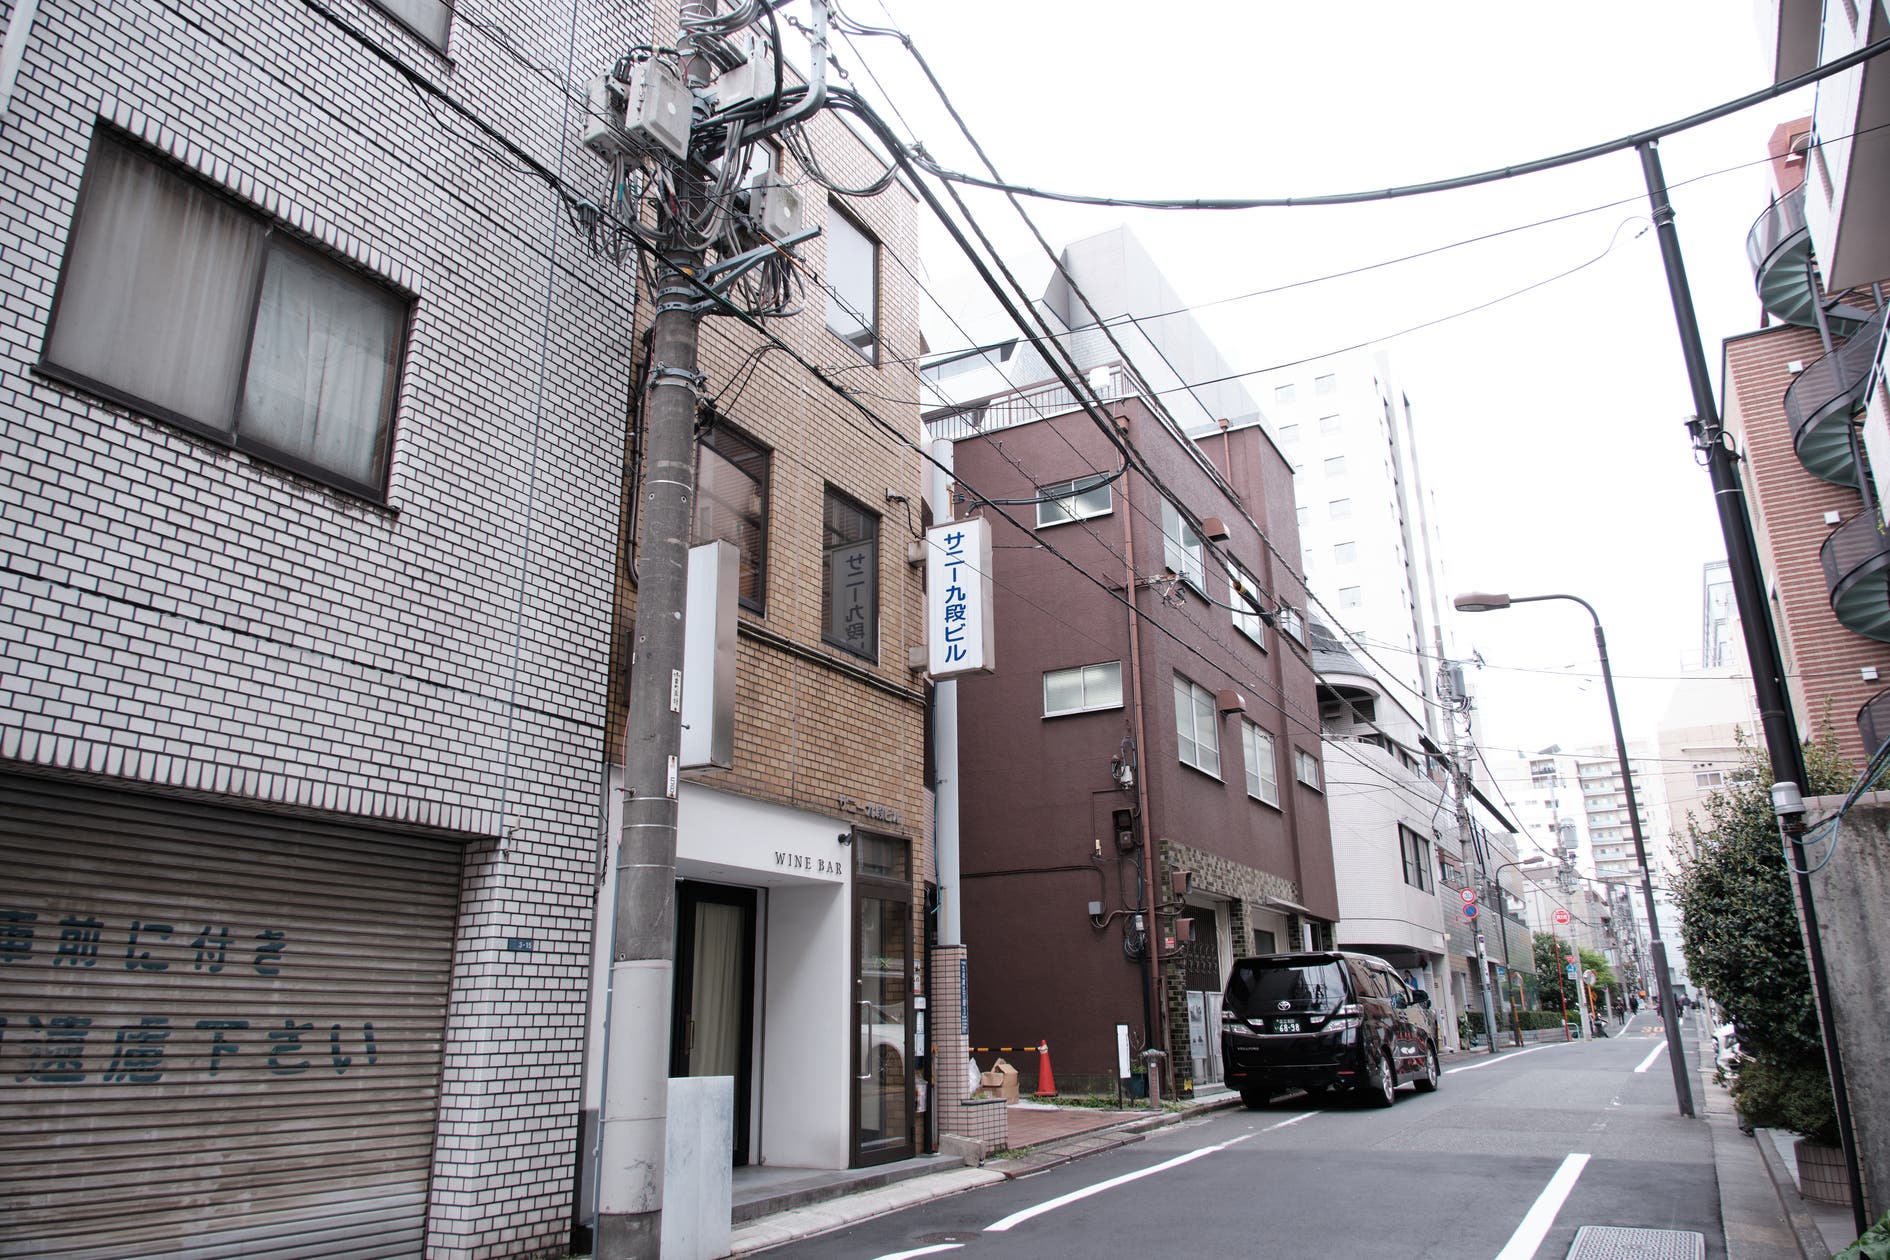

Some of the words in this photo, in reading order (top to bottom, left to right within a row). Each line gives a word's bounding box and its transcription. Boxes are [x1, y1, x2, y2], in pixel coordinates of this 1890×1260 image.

[944, 531, 967, 663] サニー九段ビル
[775, 851, 812, 870] WINE
[818, 858, 842, 875] BAR
[0, 1016, 377, 1083] 遠慮下さい
